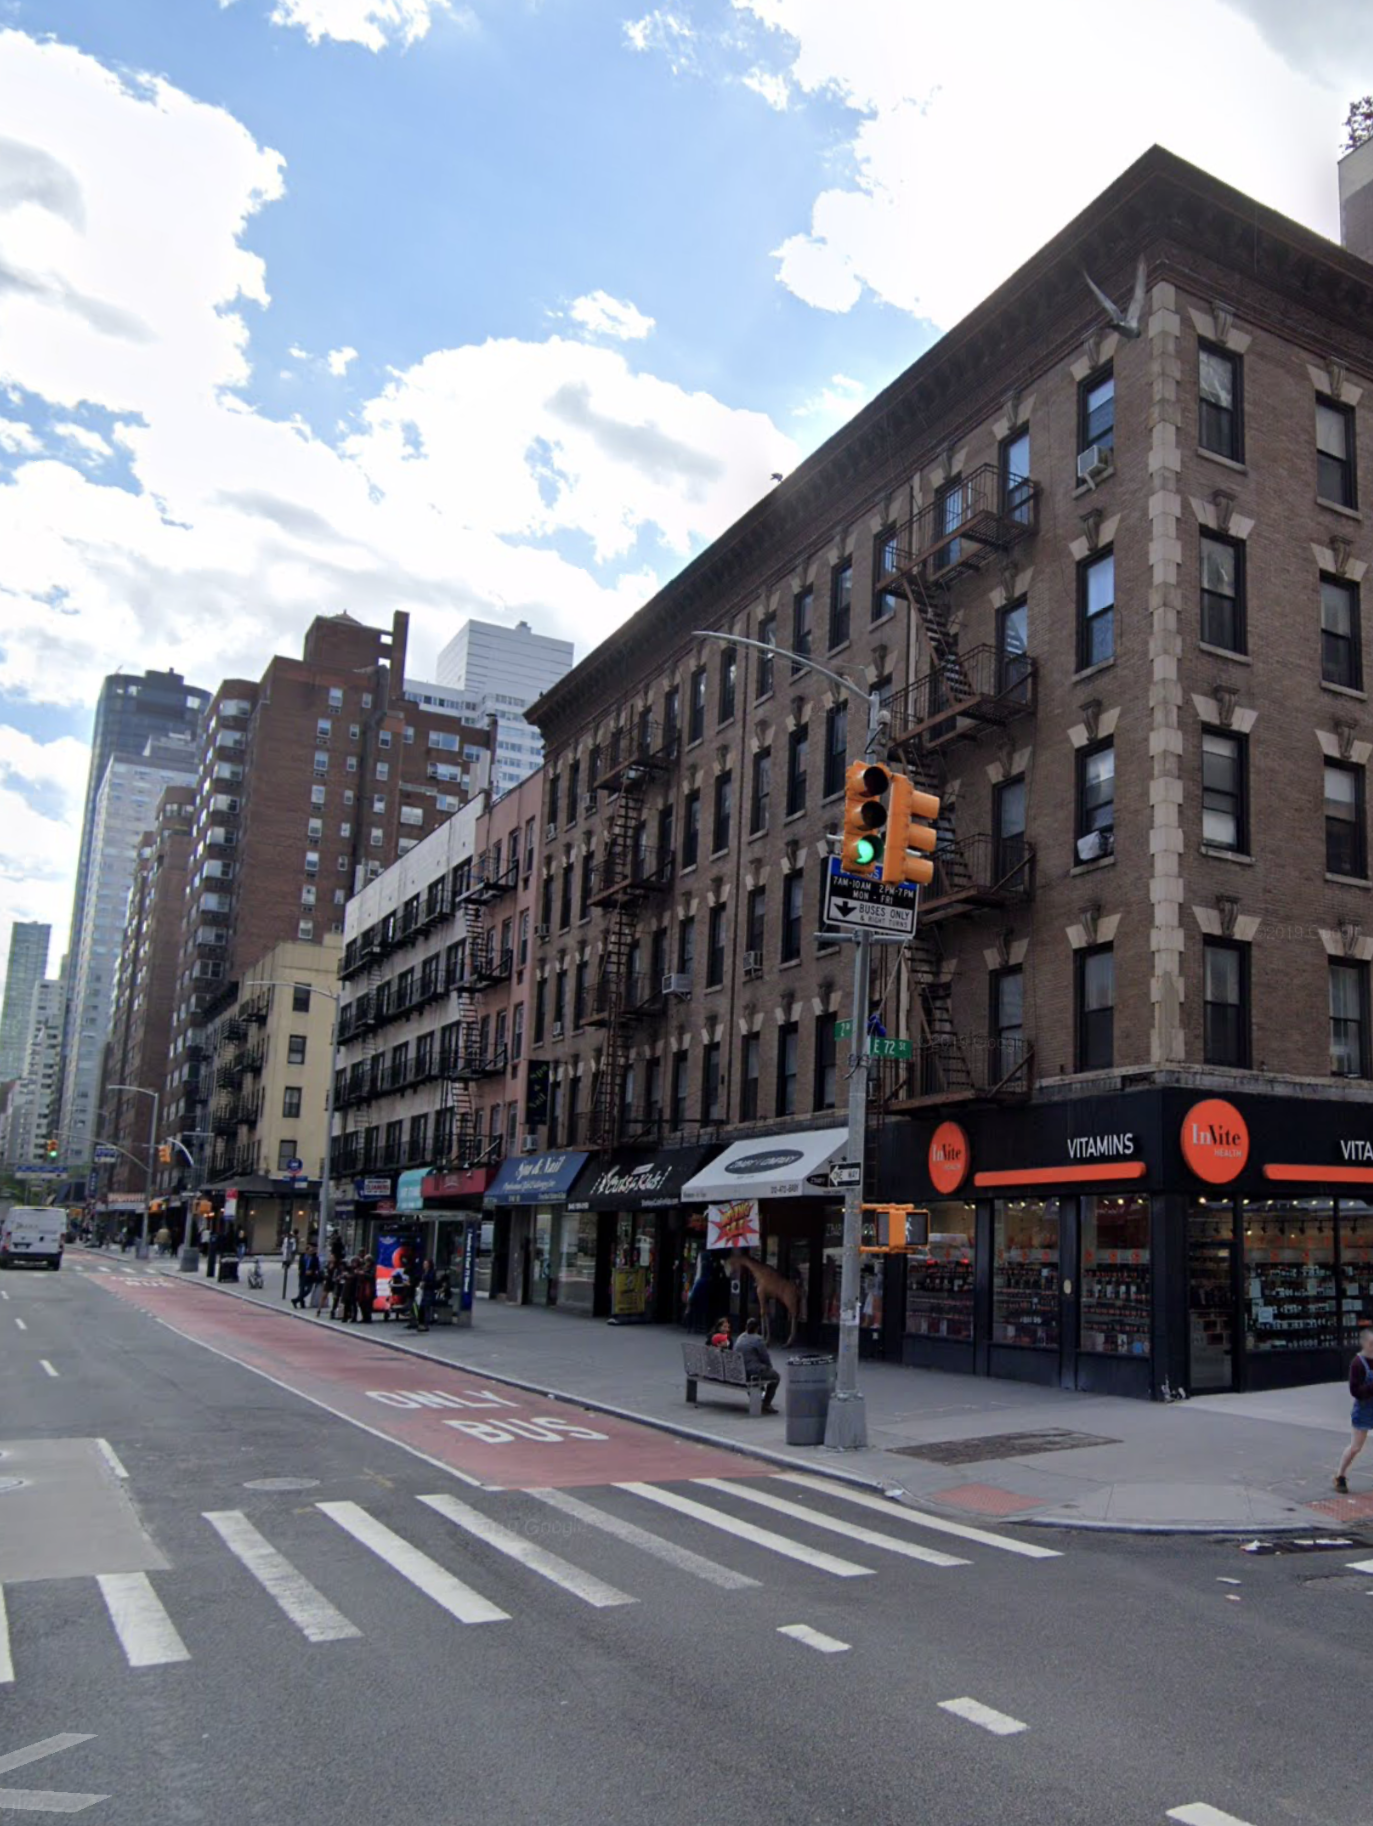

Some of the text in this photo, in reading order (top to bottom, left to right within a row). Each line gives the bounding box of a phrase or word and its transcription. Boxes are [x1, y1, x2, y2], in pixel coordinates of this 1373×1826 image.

[852, 888, 870, 900] MON
[880, 894, 894, 905] FRI
[858, 903, 910, 921] BUSES ONLY
[867, 916, 887, 925] RIGHT
[874, 1039, 880, 1054] E
[884, 1040, 896, 1055] 72
[1067, 1133, 1135, 1159] VITAMINS
[1214, 1148, 1242, 1158] HEALTH
[833, 1170, 843, 1181] ONE
[365, 1389, 521, 1409] ONLY
[441, 1417, 609, 1444] BUS
